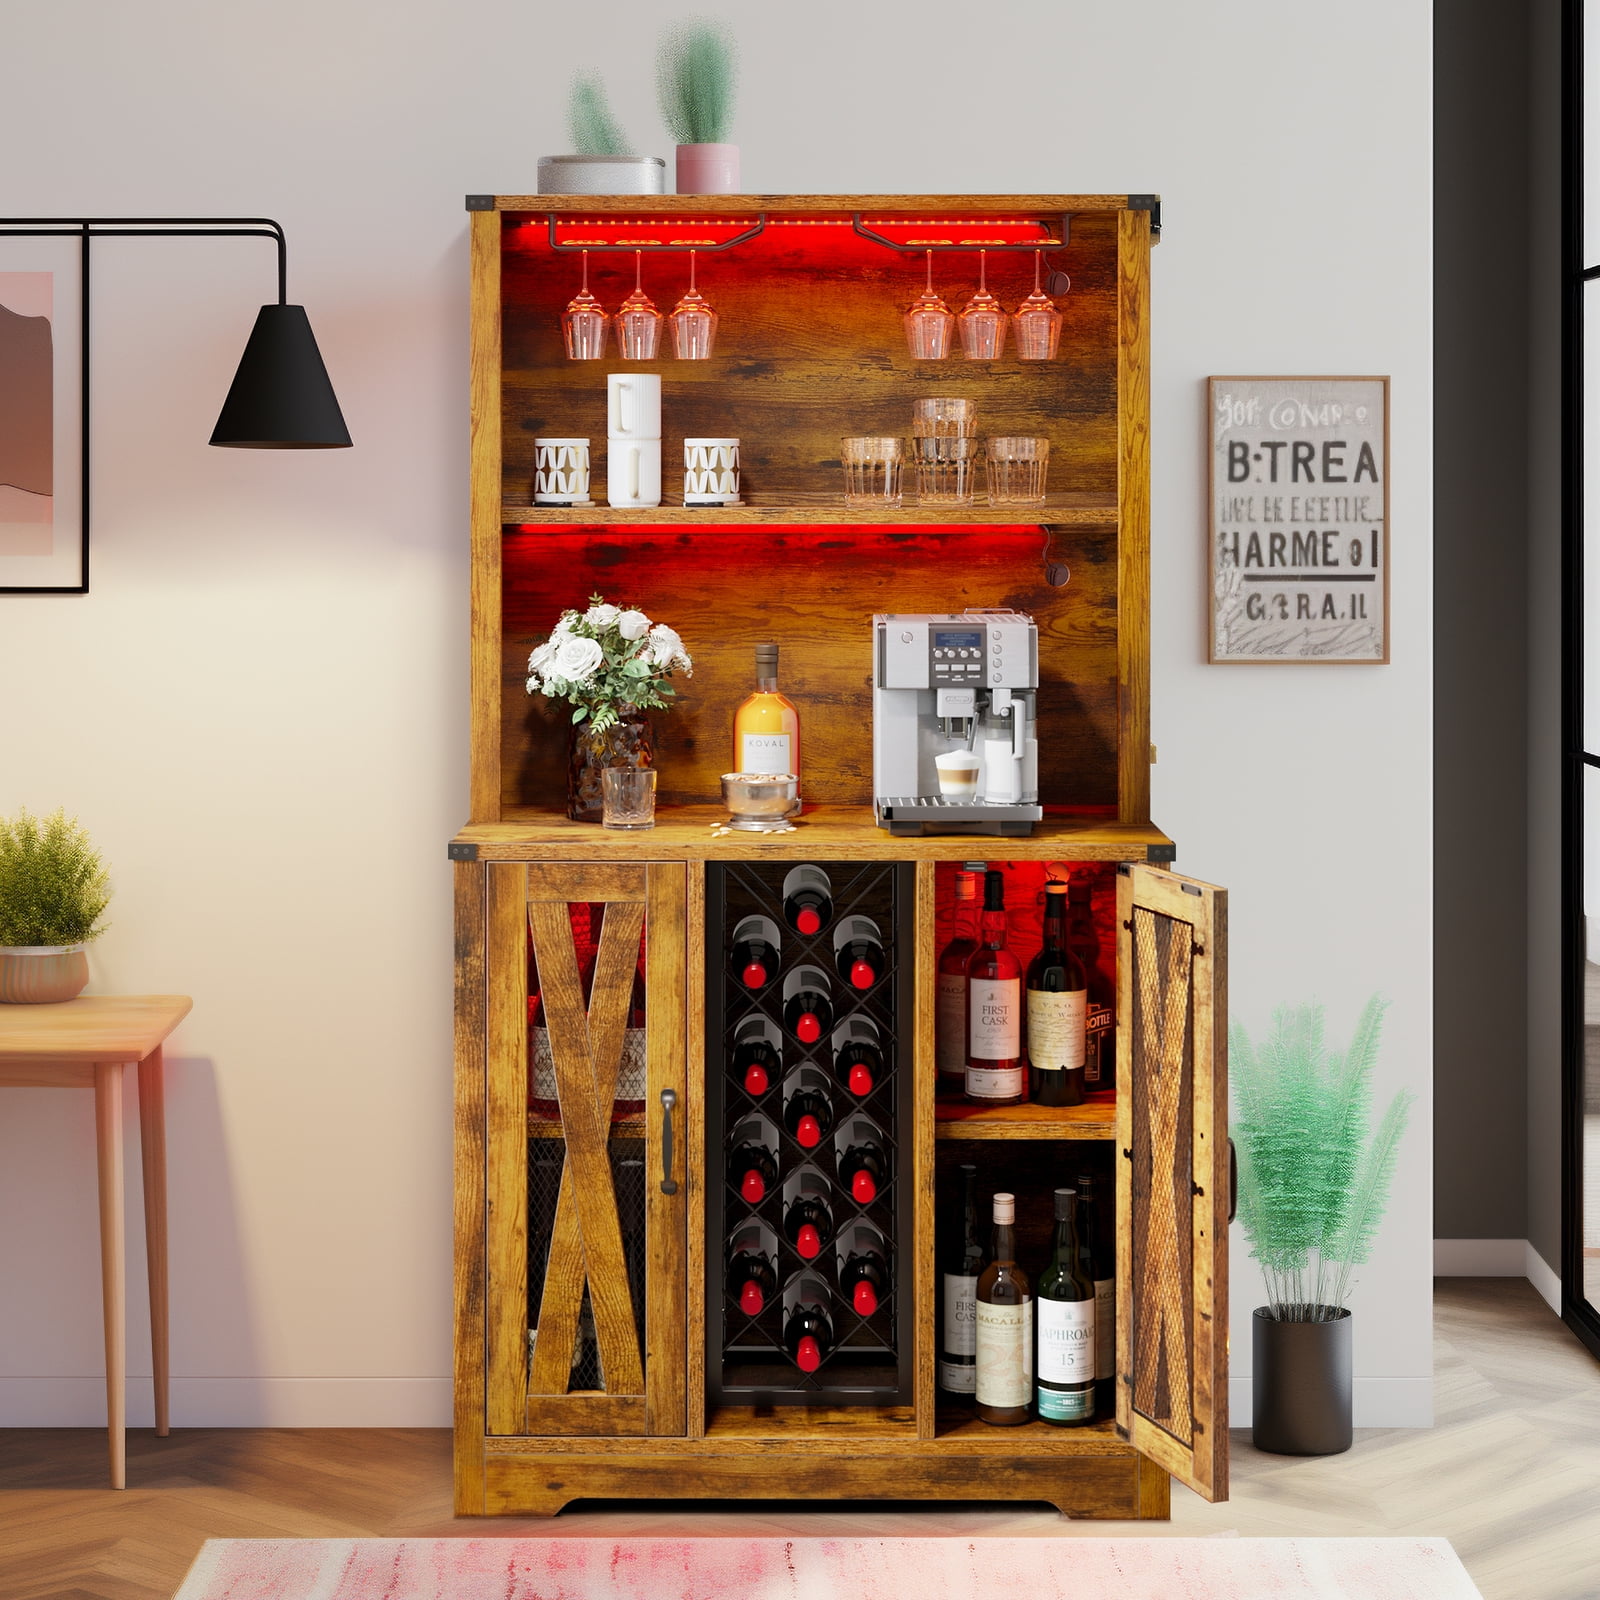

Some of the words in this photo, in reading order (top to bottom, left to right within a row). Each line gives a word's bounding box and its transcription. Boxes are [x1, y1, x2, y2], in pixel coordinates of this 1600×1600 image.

[749, 739, 785, 748] KOVAL
[982, 1005, 1009, 1015] FIRST
[981, 1016, 1009, 1026] CASK
[955, 1301, 977, 1312] FIRS
[955, 1312, 977, 1322] CAS
[1061, 1353, 1075, 1366] 15
